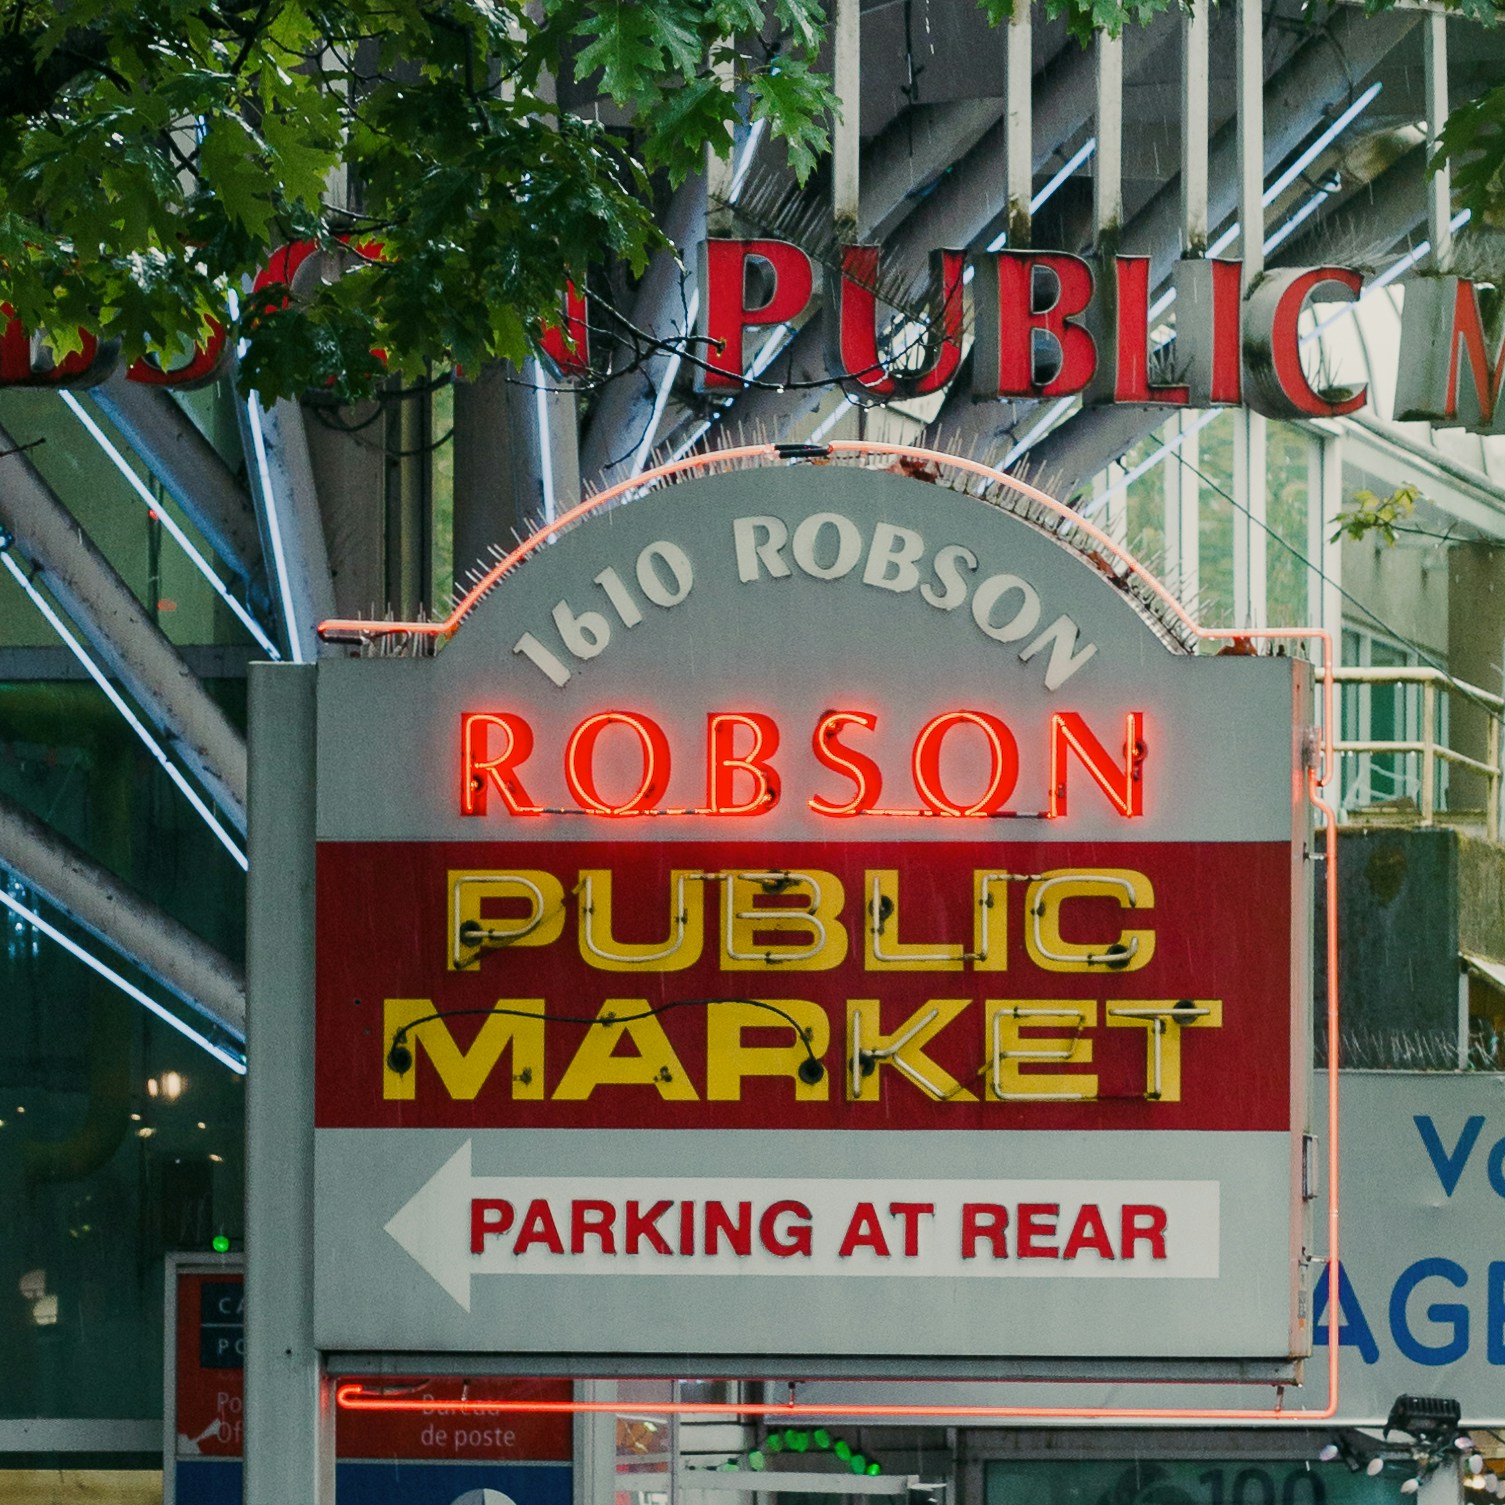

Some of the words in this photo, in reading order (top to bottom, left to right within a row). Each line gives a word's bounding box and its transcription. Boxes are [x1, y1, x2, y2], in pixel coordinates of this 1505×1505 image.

[704, 237, 1368, 419] PUBLIC
[513, 540, 694, 687] 1610
[733, 511, 1099, 691] ROBSON
[459, 710, 1145, 818] ROBSON
[446, 868, 1157, 973] PUBLIC
[382, 997, 1223, 1102] MARKET
[470, 1198, 813, 1258] PARKING
[839, 1201, 935, 1259] AT
[961, 1203, 1168, 1261] REAR
[421, 1426, 448, 1448] de
[454, 1428, 516, 1451] poste
